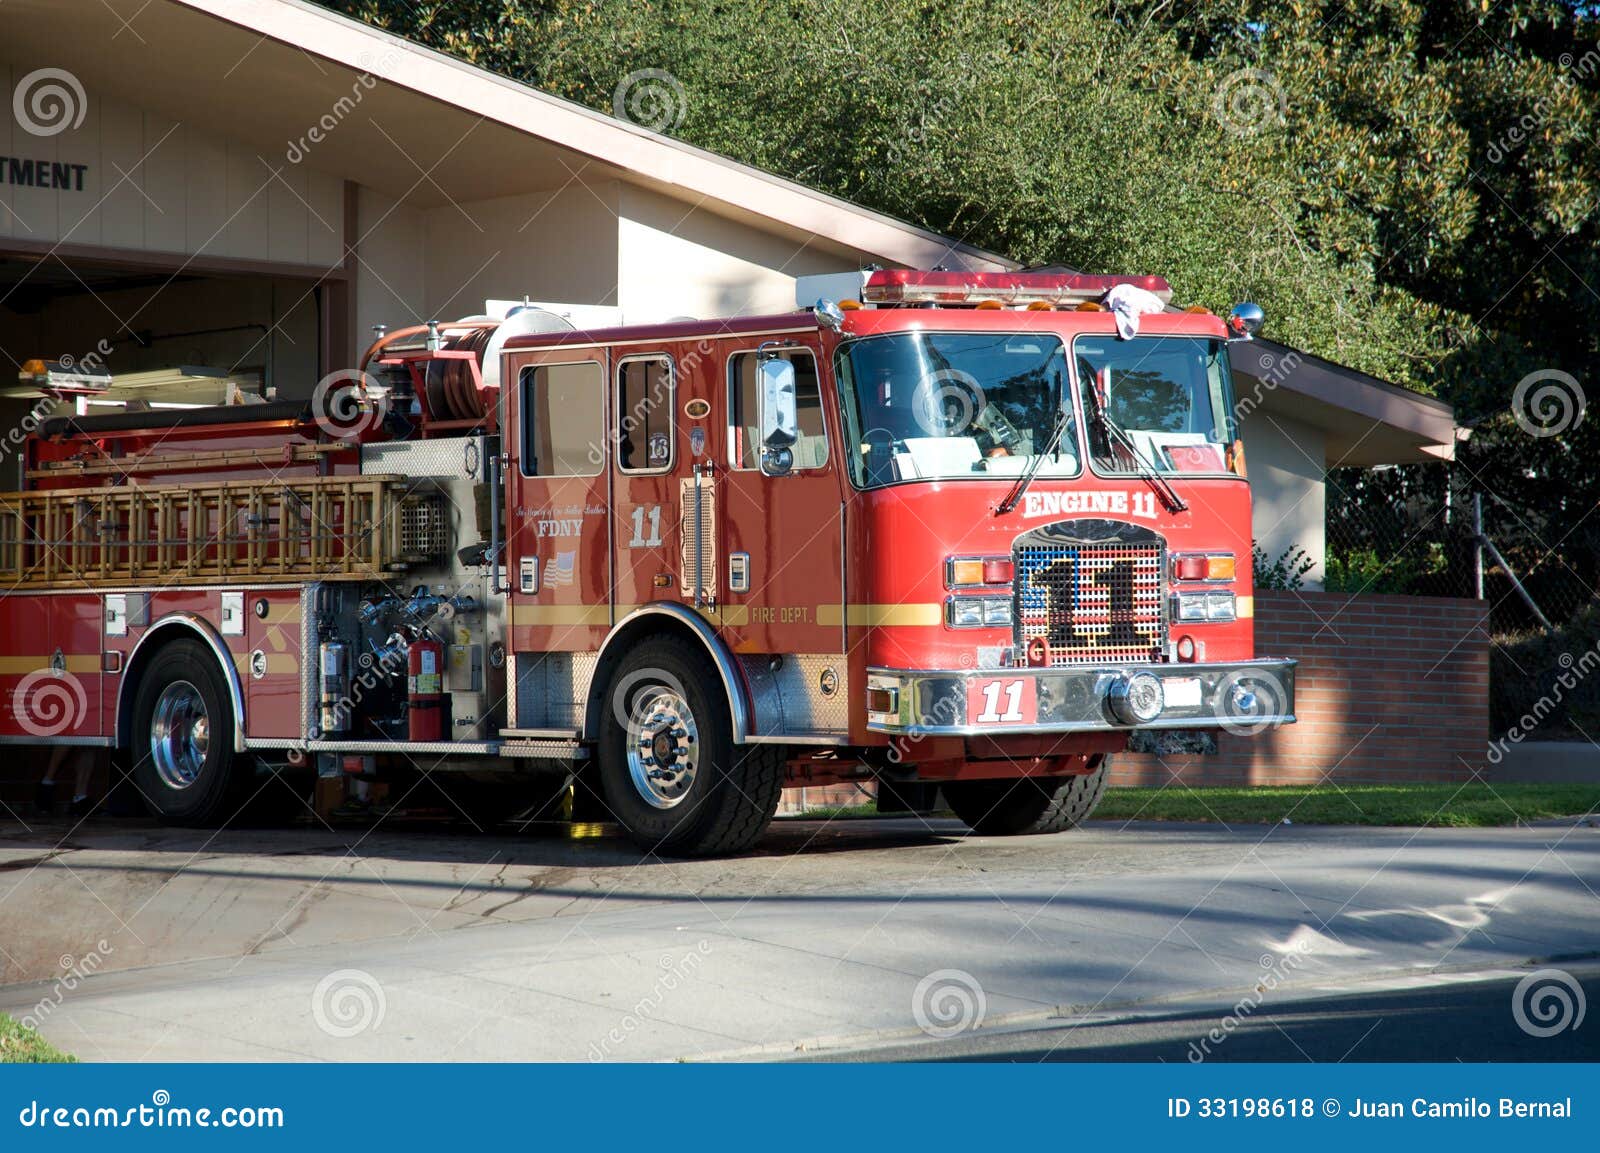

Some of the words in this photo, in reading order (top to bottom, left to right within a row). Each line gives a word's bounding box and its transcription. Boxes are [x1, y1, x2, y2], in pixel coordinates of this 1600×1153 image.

[1022, 490, 1129, 519] ENGINE
[1131, 491, 1158, 519] 11
[537, 519, 585, 538] FDNY
[629, 505, 663, 548] 11
[752, 607, 776, 623] FIRE
[780, 607, 813, 624] DEPT.
[976, 680, 1023, 723] 11
